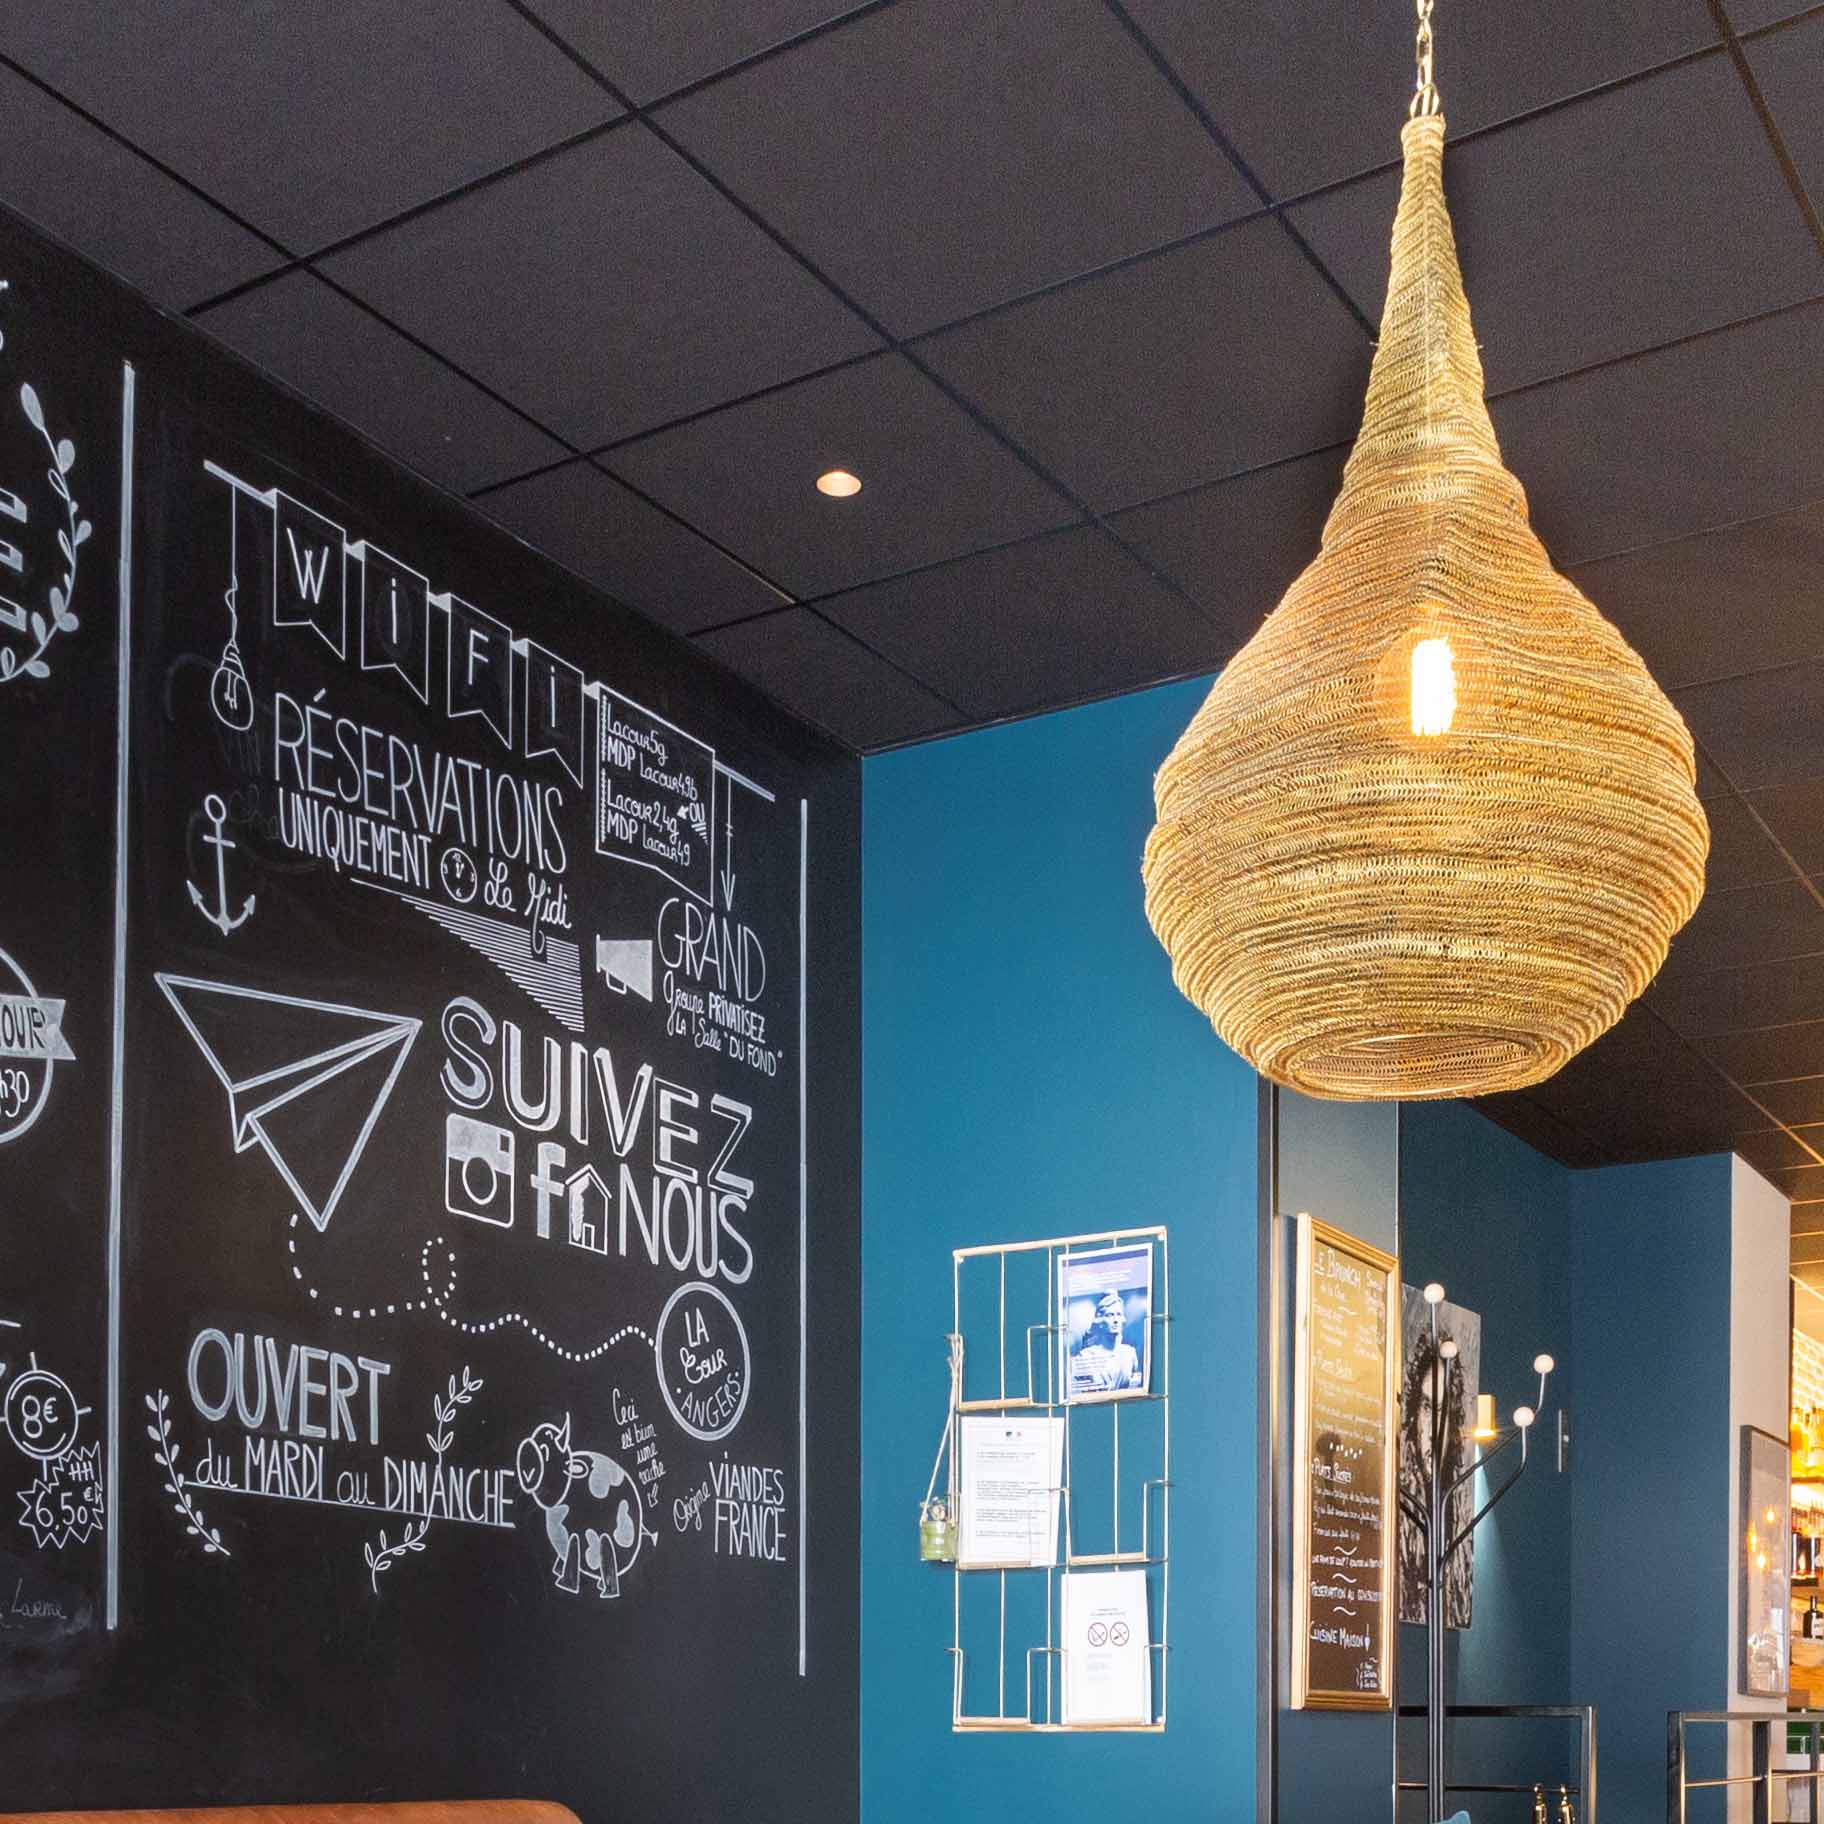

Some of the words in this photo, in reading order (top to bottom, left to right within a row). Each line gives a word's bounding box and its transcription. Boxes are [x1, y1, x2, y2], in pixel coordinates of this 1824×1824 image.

[275, 688, 567, 874] RÉSERVATIONS
[607, 736, 636, 771] MDP
[278, 787, 432, 890] UNIQUEMENT
[484, 857, 517, 912] Le
[607, 810, 639, 845] MDP
[658, 897, 766, 1002] GRAND
[440, 995, 754, 1200] SUIVEZ
[619, 1163, 754, 1285] NOUS
[685, 1307, 710, 1348] LA
[187, 1327, 392, 1446] OUVERT
[680, 1377, 742, 1428] ANGERS
[195, 1437, 238, 1489] du
[245, 1435, 323, 1500] MARDI
[384, 1455, 516, 1528] DIMANCHE
[715, 1499, 786, 1561] FRANCE
